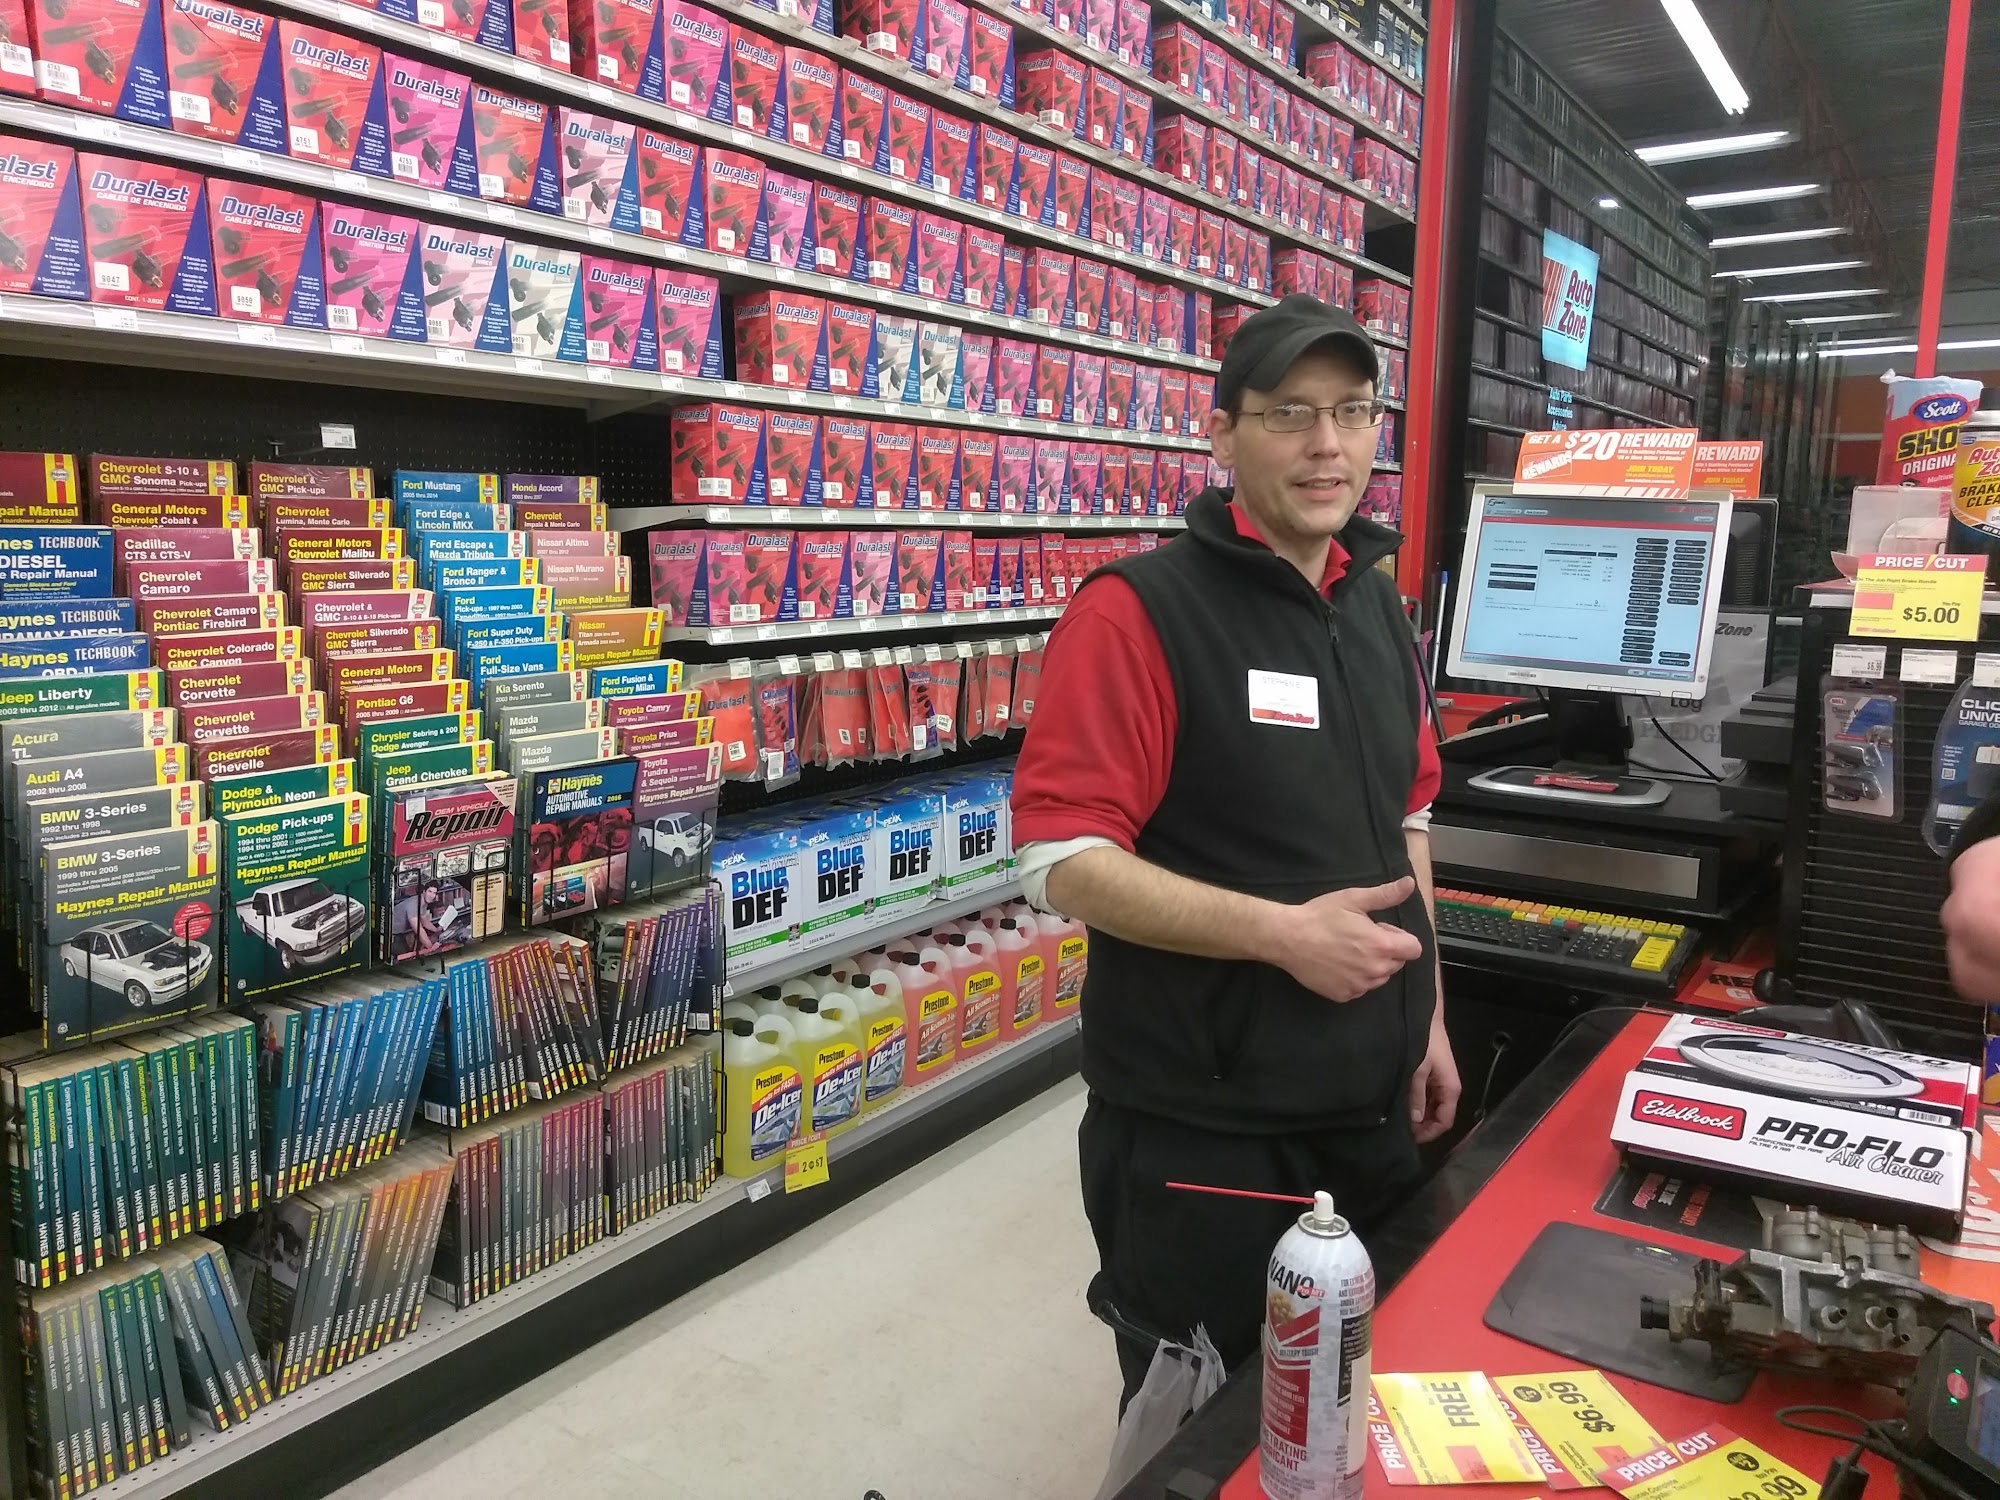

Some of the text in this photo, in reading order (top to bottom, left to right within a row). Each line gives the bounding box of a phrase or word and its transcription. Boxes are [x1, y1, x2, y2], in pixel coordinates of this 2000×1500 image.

[291, 37, 370, 73] Duralast
[393, 70, 461, 102] Duralast
[568, 122, 626, 148] Duralast
[0, 157, 58, 180] alast
[89, 172, 190, 205] Duralast
[96, 191, 187, 211] CABLES DE ENCENDIDO
[332, 219, 408, 246] Duralast
[358, 240, 406, 253] IGNITION WIRES
[513, 254, 573, 277] Duralast
[101, 274, 120, 284] 9047
[1566, 270, 1593, 311] Auto
[775, 302, 819, 320] Duralast
[1557, 300, 1587, 343] Zone
[1547, 403, 1573, 419] Accessories
[1924, 401, 1959, 418] Scott
[718, 410, 760, 427] Duralast
[1528, 434, 1551, 444] GET
[1551, 433, 1562, 444] A
[1565, 432, 1620, 460] $20
[1619, 433, 1694, 448] REWARD
[1897, 425, 1961, 460] SHO
[1699, 446, 1760, 461] REWARD
[100, 462, 199, 476] Chevrolet S-10 &
[1522, 450, 1572, 480] REWARDS
[1902, 454, 1956, 475] ORIGINA
[100, 474, 207, 488] GMC Sonoma Pick-ups
[402, 480, 461, 492] Ford Mustang
[512, 483, 563, 493] Honda Accord
[1967, 494, 2000, 508] CLEA
[0, 506, 78, 518] pair Manual
[39, 537, 101, 549] TECHBOOK
[124, 538, 176, 550] Cadillac
[288, 539, 372, 548] General Motors
[537, 539, 589, 548] Nissan Altima
[805, 542, 842, 555] Duralast
[0, 555, 66, 569] DIESEL
[125, 550, 191, 560] CTS & CTS-V
[288, 549, 375, 559] Chevrolet Malibu
[1875, 556, 1969, 569] PRICE CUT
[11, 569, 97, 579] Repair Manual
[443, 567, 506, 578] Ford Ranger &
[443, 577, 476, 585] Bronco
[153, 605, 257, 620] Chevrolet Camaro
[1903, 607, 1960, 623] $5.00
[154, 617, 247, 632] Pontiac Firebird
[1716, 623, 1753, 635] Zone
[480, 656, 501, 665] Ford
[480, 663, 544, 675] Full-Size Vans
[38, 688, 92, 702] Liberty
[496, 681, 544, 694] Kia Sorento
[601, 683, 655, 696] Mercury Milan
[356, 696, 414, 709] Pontiac G6
[618, 703, 671, 717] Toyota Camry
[707, 695, 747, 711] Duralast
[1961, 699, 2000, 711] CLIC
[1960, 710, 2000, 722] UNIVE
[371, 731, 411, 743] Chrysler
[412, 730, 438, 739] Sebring
[446, 726, 458, 734] 200
[26, 768, 84, 785] Audi A4
[386, 765, 411, 777] Jeep
[386, 767, 467, 787] Grand Cherokee
[562, 774, 603, 791] Haynes
[546, 790, 588, 806] AUTOMOTIVE
[546, 794, 621, 815] REPAIR MANUALS 2016
[435, 802, 490, 816] OEM VEHICLE
[237, 813, 334, 837] Dodge Pick-ups
[403, 801, 511, 843] Repair
[450, 827, 498, 840] INFORMATION
[57, 844, 161, 869] BMW 3-Series
[721, 852, 746, 869] PEAK
[57, 865, 118, 880] 1999 thru 2005
[731, 866, 788, 899] Blue
[56, 897, 114, 914] Haynes
[118, 887, 165, 904] Repair
[168, 876, 216, 894] Manual
[67, 912, 91, 920] Based
[109, 903, 141, 915] complete
[176, 893, 188, 901] and
[188, 888, 210, 899] rebuild
[733, 888, 788, 930] DEF
[1062, 942, 1083, 957] Prestone
[968, 976, 994, 992] Prestone
[756, 1073, 782, 1090] Prestone
[754, 1089, 802, 1131] De-Icer
[1641, 1099, 1734, 1132] Edelbrock
[791, 1138, 808, 1148] PRICE
[1751, 1136, 1796, 1148] PURIFICADOR
[1756, 1116, 1945, 1169] PRO-FLO
[802, 1157, 824, 1173] 2 $7
[1826, 1147, 1944, 1185] Air Cleaner
[213, 1162, 222, 1194] HAYNES
[72, 1210, 82, 1245] HAYNES
[39, 1223, 49, 1257] HAYNES
[1269, 1256, 1314, 1300] NANO
[1296, 1286, 1325, 1298] Pro MT
[1431, 1381, 1481, 1428] FREE
[1549, 1381, 1616, 1433] $6.99
[1372, 1423, 1406, 1469] PRICE
[1616, 1450, 1678, 1483] PRICE
[1677, 1432, 1718, 1457] CUT
